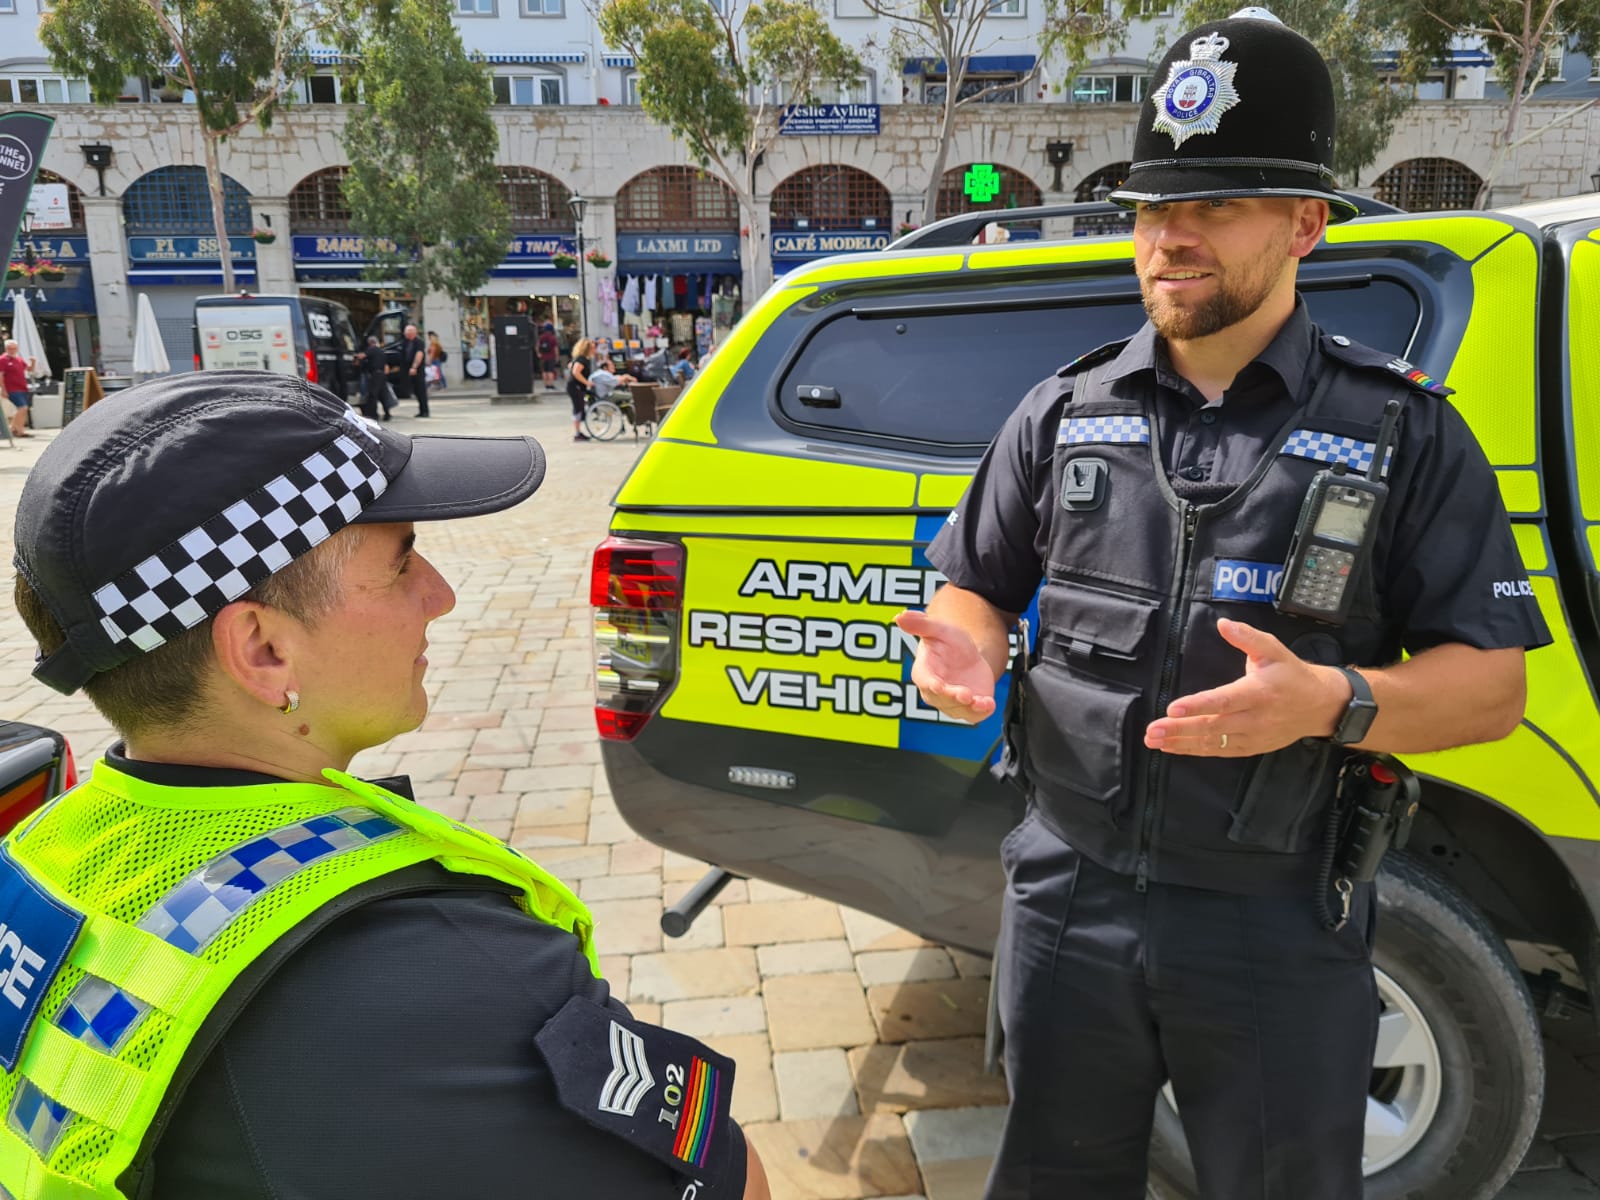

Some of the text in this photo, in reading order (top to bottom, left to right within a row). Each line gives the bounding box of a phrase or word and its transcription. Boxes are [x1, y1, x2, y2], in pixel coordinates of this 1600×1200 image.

[1166, 69, 1216, 99] ROYAL GIBRALTAR
[830, 104, 877, 120] Ayling
[1172, 108, 1199, 119] POLICE
[0, 144, 19, 160] THE
[526, 241, 559, 254] THAT
[636, 239, 722, 254] LAXMI LTD
[774, 233, 888, 252] CAFÉ MODELO
[226, 330, 263, 341] OSG
[1216, 566, 1285, 595] POLIC
[1493, 580, 1534, 599] POLICE
[690, 612, 1018, 670] RESPON
[728, 668, 980, 724] VEHICL
[658, 1063, 685, 1130] 102
